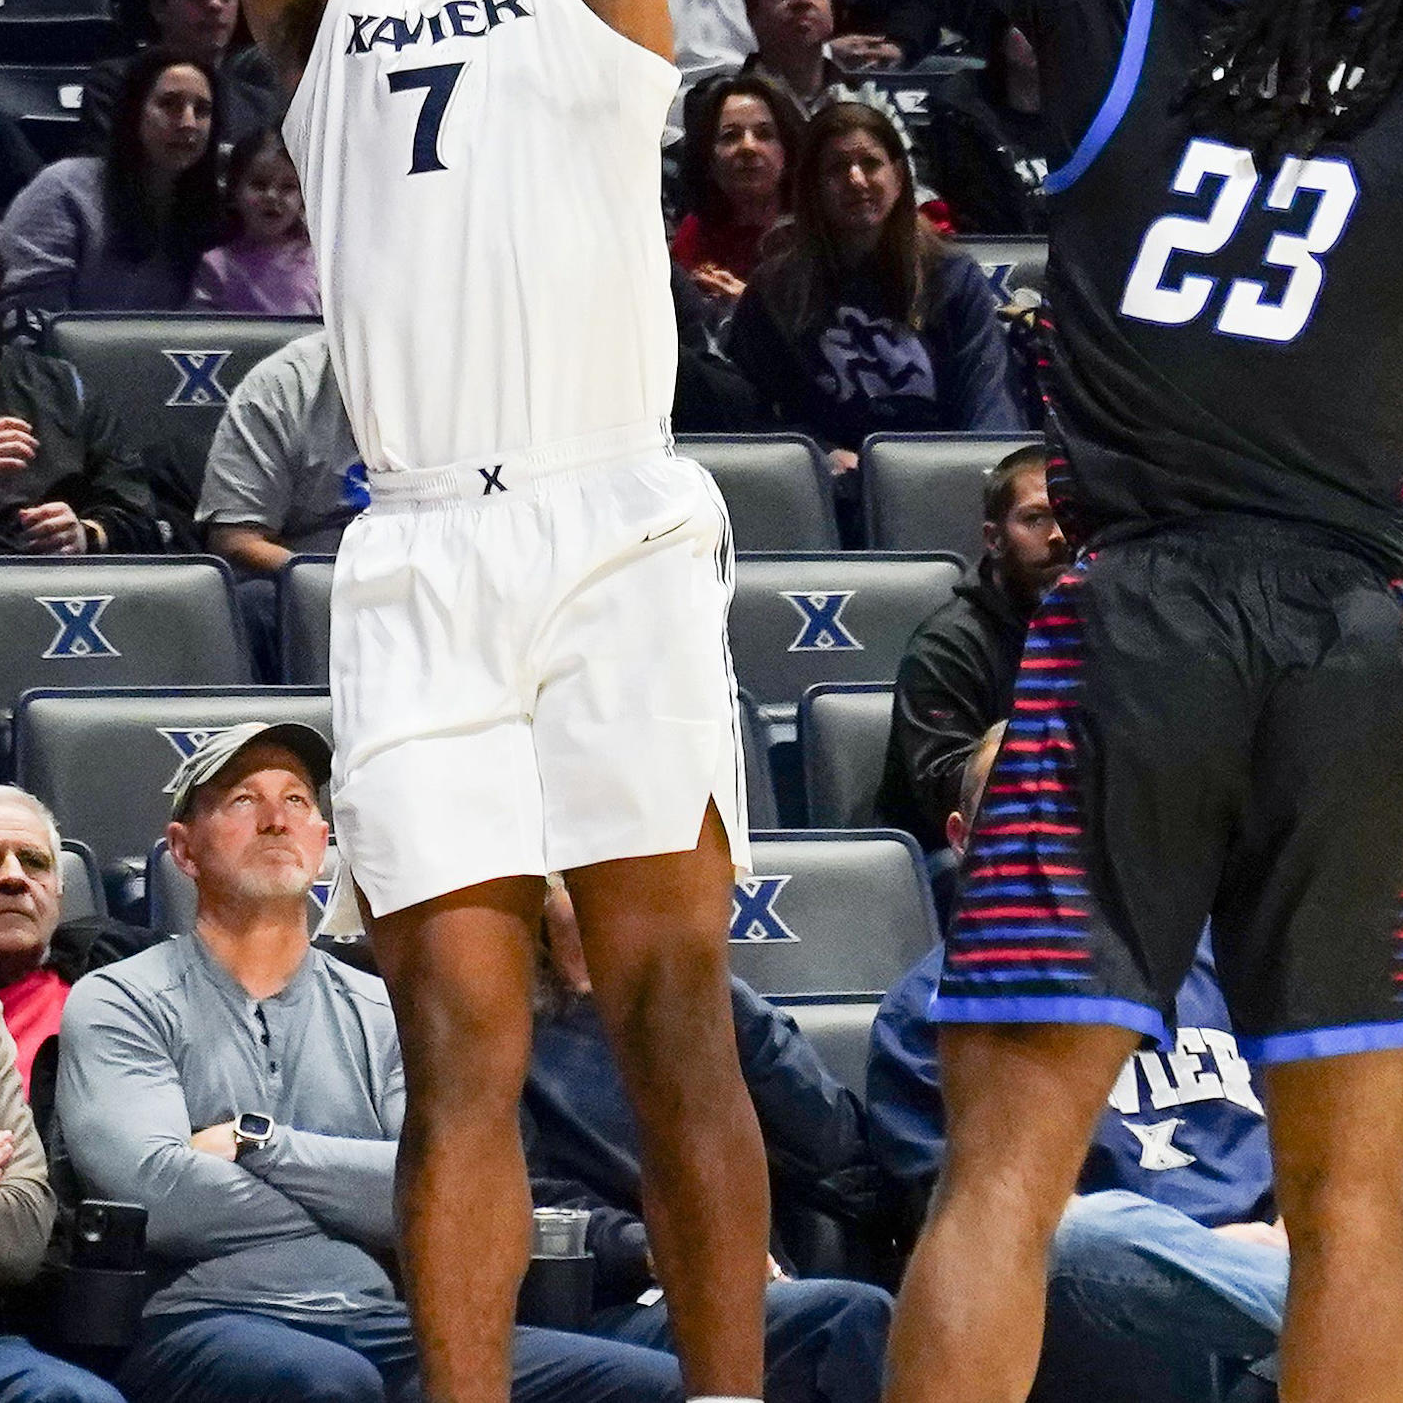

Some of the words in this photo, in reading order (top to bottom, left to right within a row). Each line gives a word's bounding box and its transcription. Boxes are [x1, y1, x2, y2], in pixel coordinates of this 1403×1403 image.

[387, 61, 467, 176] 7
[1118, 136, 1361, 344] 23
[160, 349, 233, 407] X
[478, 464, 508, 496] X
[34, 595, 122, 659] X
[778, 590, 865, 652] X
